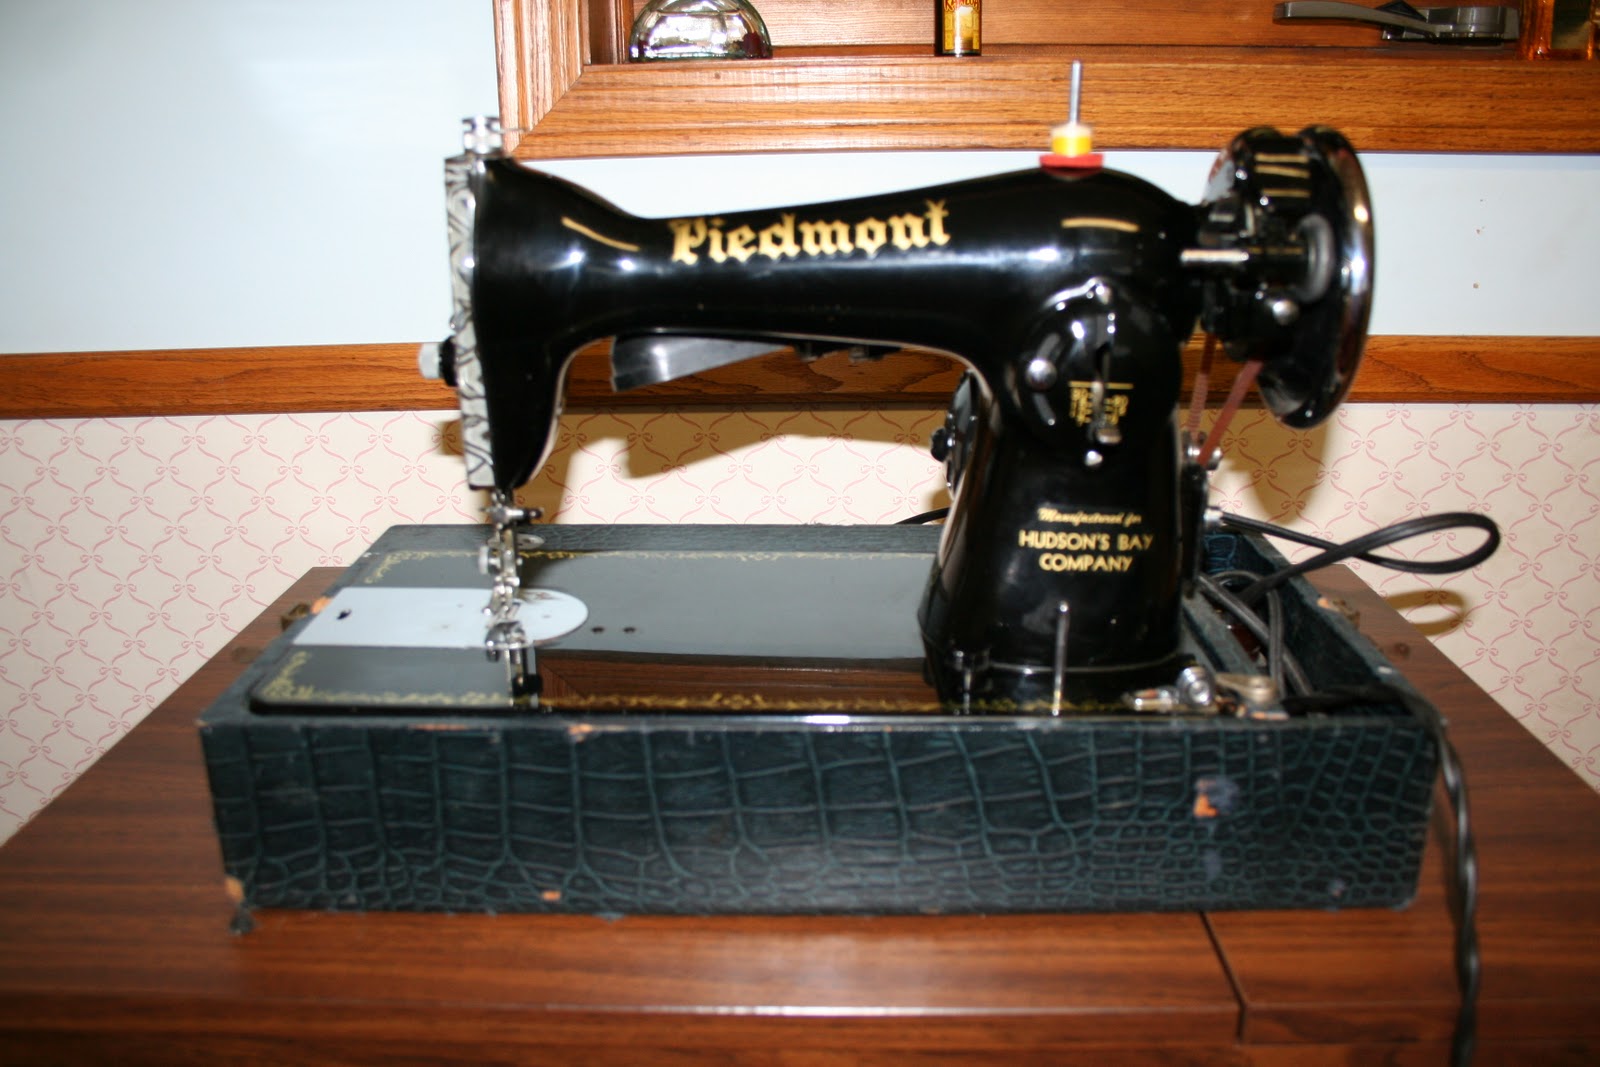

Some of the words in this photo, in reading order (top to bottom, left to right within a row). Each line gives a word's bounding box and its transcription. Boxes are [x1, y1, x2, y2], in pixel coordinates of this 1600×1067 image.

[669, 199, 951, 266] Piedmont
[1037, 507, 1123, 526] Manufactured
[1018, 530, 1111, 551] HUDSON'S
[1117, 533, 1153, 551] BAY
[1039, 552, 1133, 572] COMPANY
